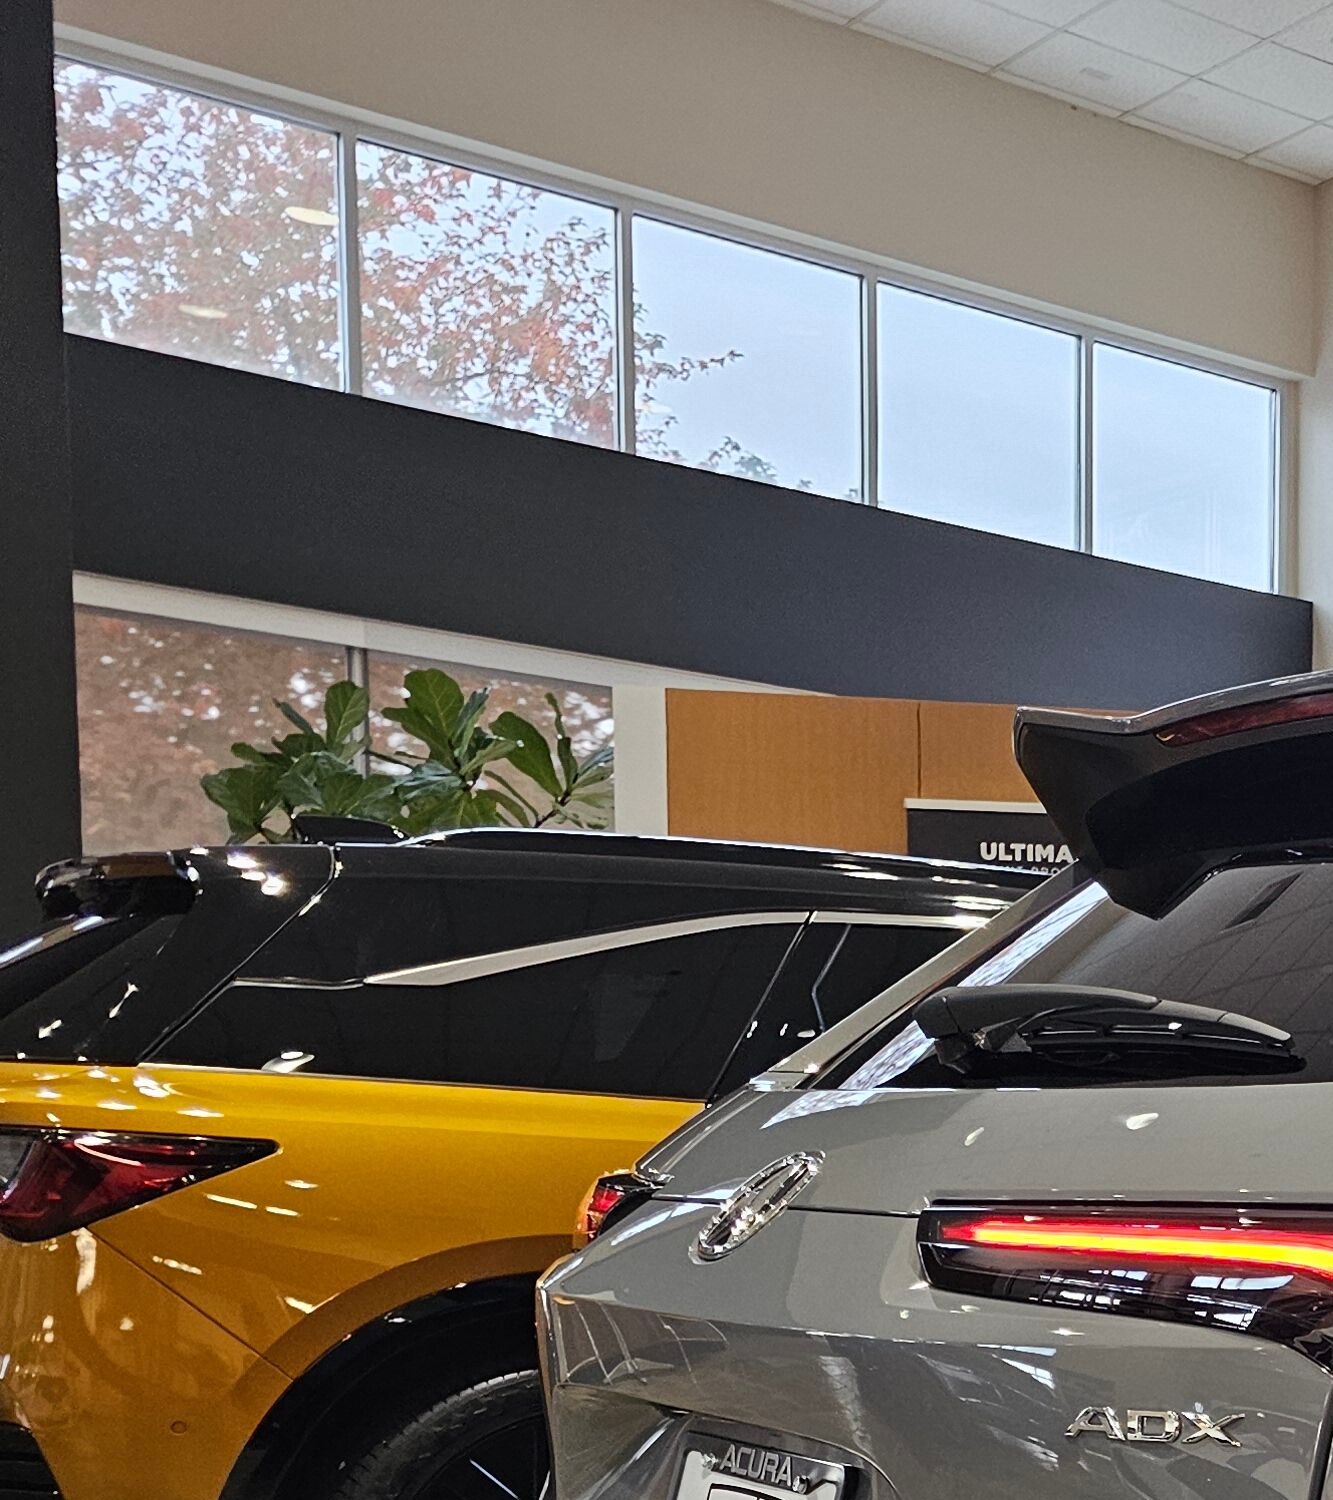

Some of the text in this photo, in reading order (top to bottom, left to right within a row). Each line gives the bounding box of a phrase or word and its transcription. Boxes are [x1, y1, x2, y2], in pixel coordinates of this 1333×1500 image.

[980, 841, 1073, 863] ULTIMA
[1064, 1406, 1246, 1447] ADX
[719, 1443, 793, 1488] ACURA
